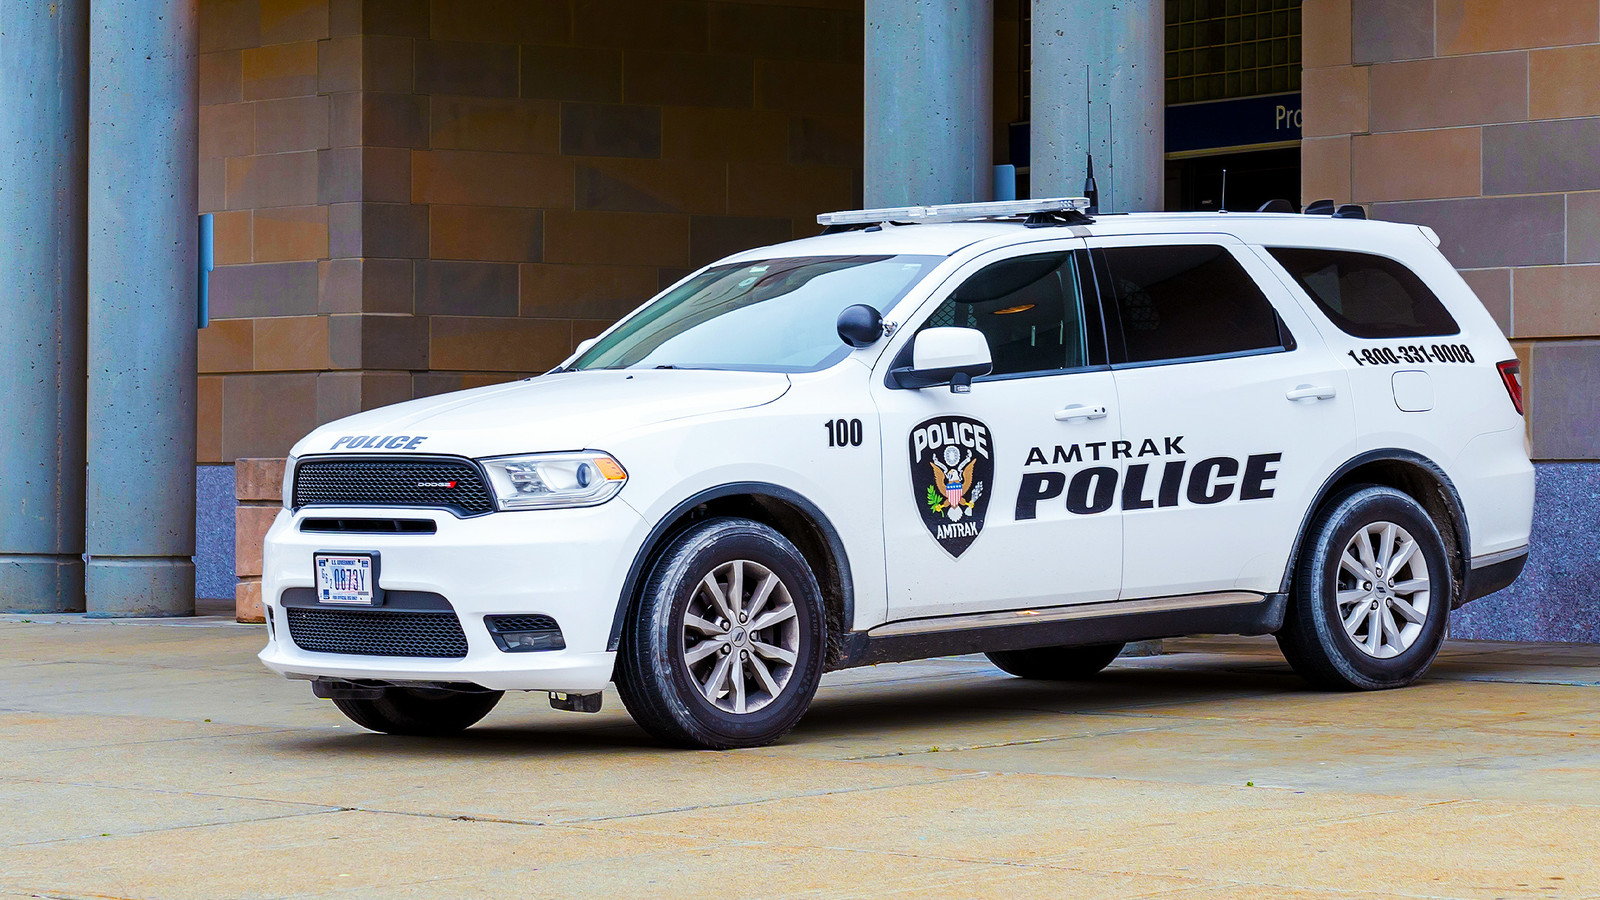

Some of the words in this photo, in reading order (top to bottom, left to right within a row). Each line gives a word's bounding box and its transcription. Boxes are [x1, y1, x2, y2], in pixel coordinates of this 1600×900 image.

[1348, 344, 1475, 366] 1-800-331-0008
[329, 435, 428, 450] POLICE
[825, 419, 863, 447] 100
[913, 422, 989, 463] POLICE
[1024, 436, 1186, 466] AMTRAK
[1014, 452, 1283, 521] POLICE
[936, 521, 979, 540] AMTRAK
[334, 568, 365, 591] 0873Y
